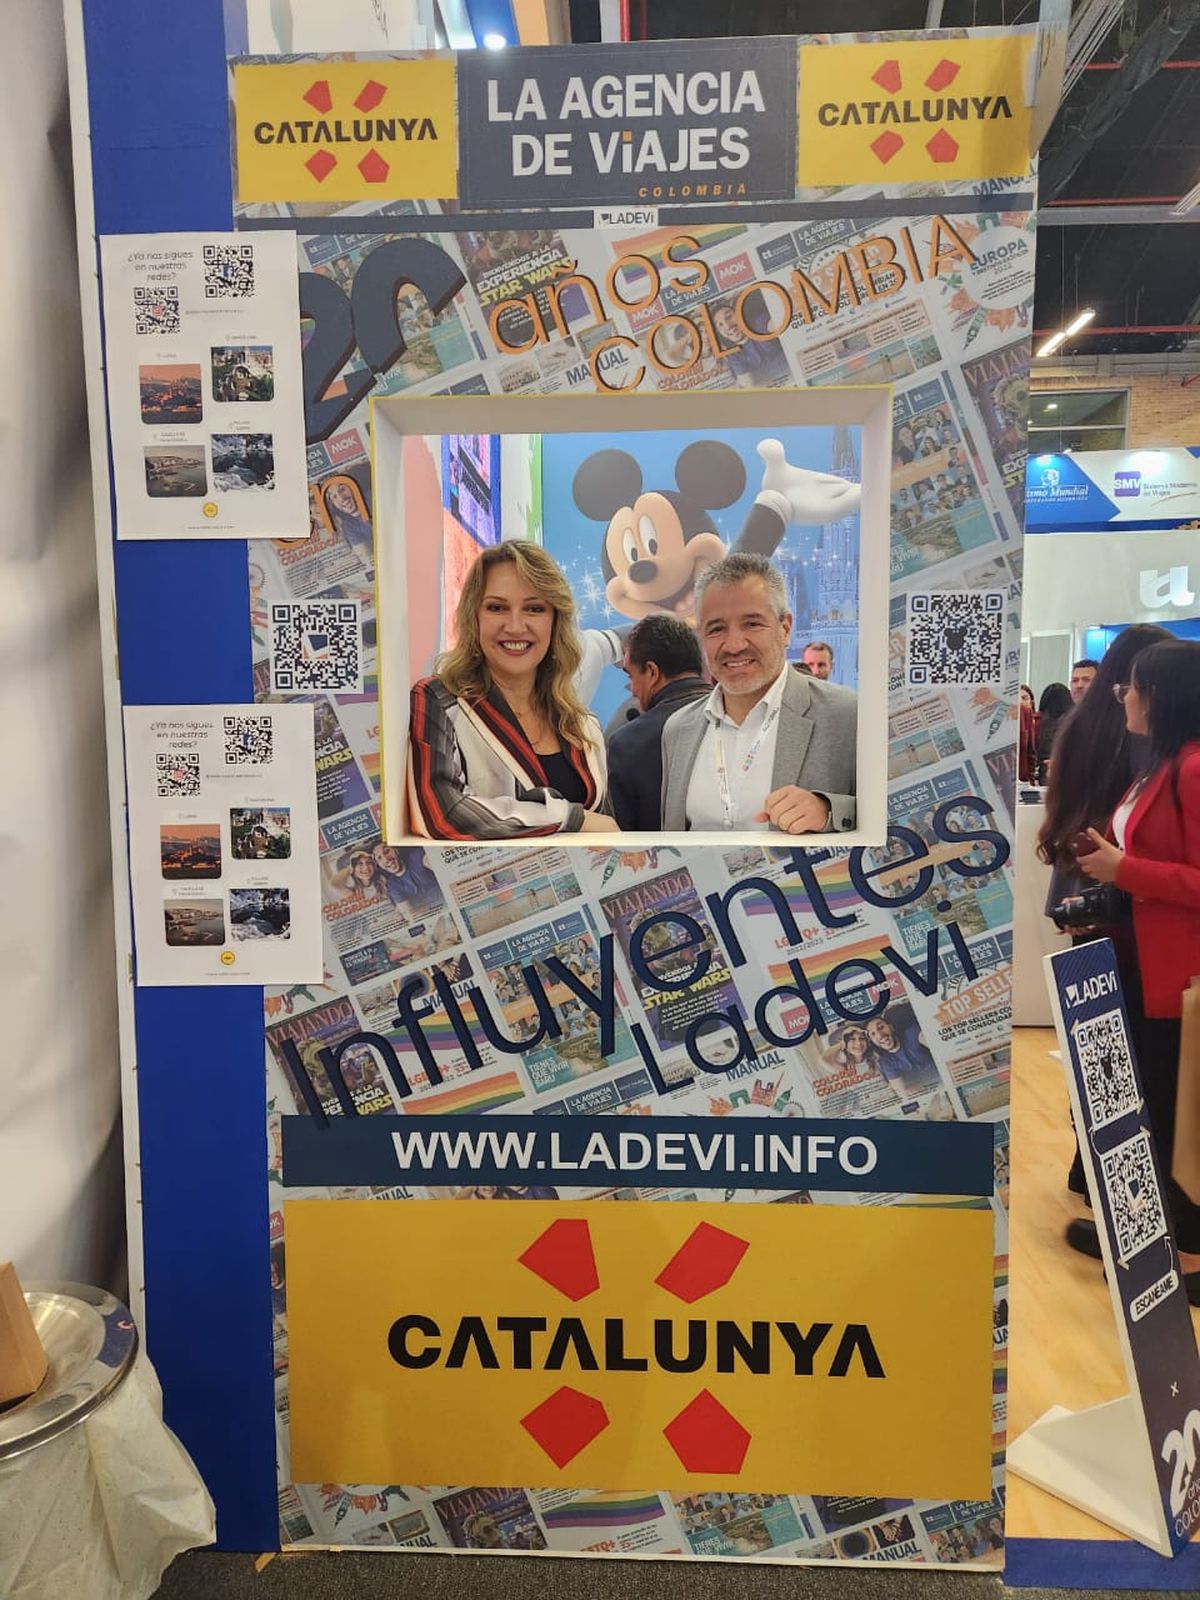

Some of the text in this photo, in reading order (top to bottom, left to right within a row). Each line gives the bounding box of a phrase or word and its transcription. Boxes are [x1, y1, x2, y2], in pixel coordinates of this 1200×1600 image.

[488, 70, 766, 122] LA AGENCIA
[818, 96, 1012, 126] CATALUNYA
[254, 118, 438, 144] CATALUNYA
[511, 133, 572, 177] DE
[639, 183, 746, 198] COLOMBIA
[476, 248, 563, 293] EXPERIENCIA
[719, 260, 747, 281] MOK
[480, 279, 523, 308] STAR
[589, 214, 978, 394] COLOMBIA
[566, 348, 629, 386] MAUAL
[1114, 479, 1140, 489] SMV
[602, 874, 693, 919] VIAJANDO
[688, 968, 731, 993] WARS
[943, 994, 972, 1018] TOP
[265, 1002, 354, 1049] VIAJANDO
[391, 1131, 878, 1176] WWW.LADEVI.INFO
[387, 1314, 887, 1379] CATALUNYA
